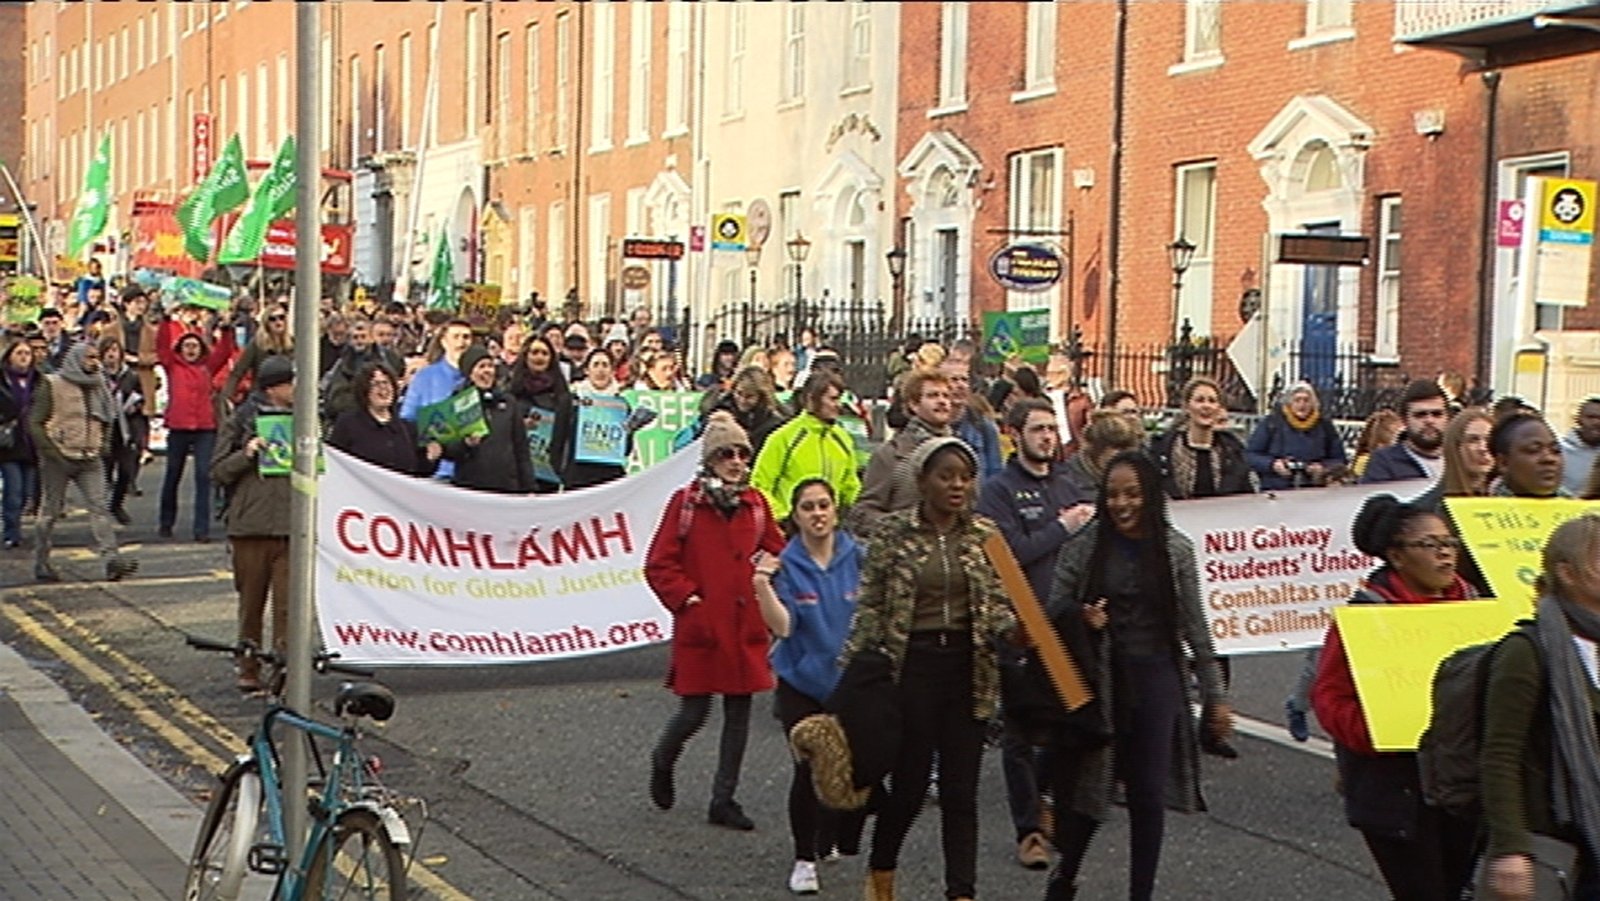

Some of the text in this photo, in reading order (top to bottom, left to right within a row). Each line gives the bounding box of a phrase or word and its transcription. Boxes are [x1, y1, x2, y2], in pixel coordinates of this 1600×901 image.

[336, 509, 634, 570] COMHLÁMH
[1204, 526, 1333, 553] NUI Galway
[1311, 550, 1374, 573] Union
[336, 564, 646, 599] Action for Global Justice
[1208, 581, 1320, 611] Comhaltas
[1325, 583, 1350, 600] na
[335, 619, 664, 656] www.comhlamh.org
[1245, 609, 1332, 636] Gaillimh
